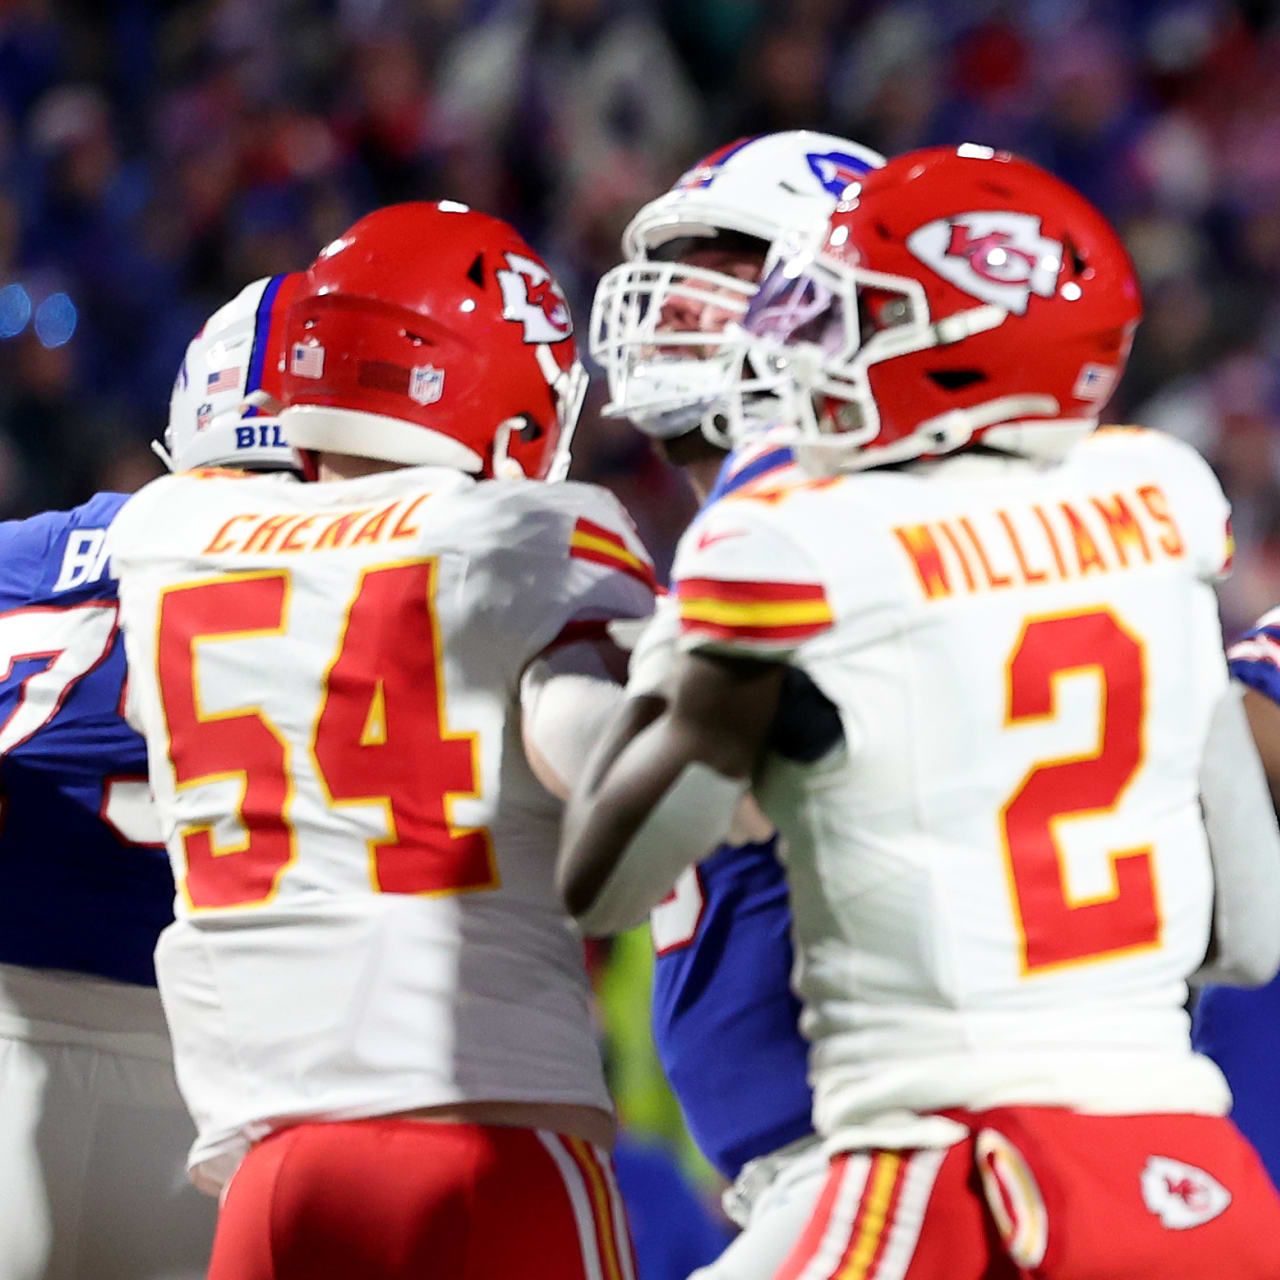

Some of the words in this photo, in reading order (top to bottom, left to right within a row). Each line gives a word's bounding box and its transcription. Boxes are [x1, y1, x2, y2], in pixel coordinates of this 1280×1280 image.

[235, 424, 288, 449] BIL
[203, 494, 433, 554] CHENAL
[893, 483, 1186, 601] WILLIAMS
[155, 555, 499, 912] 54
[1000, 606, 1163, 976] 2
